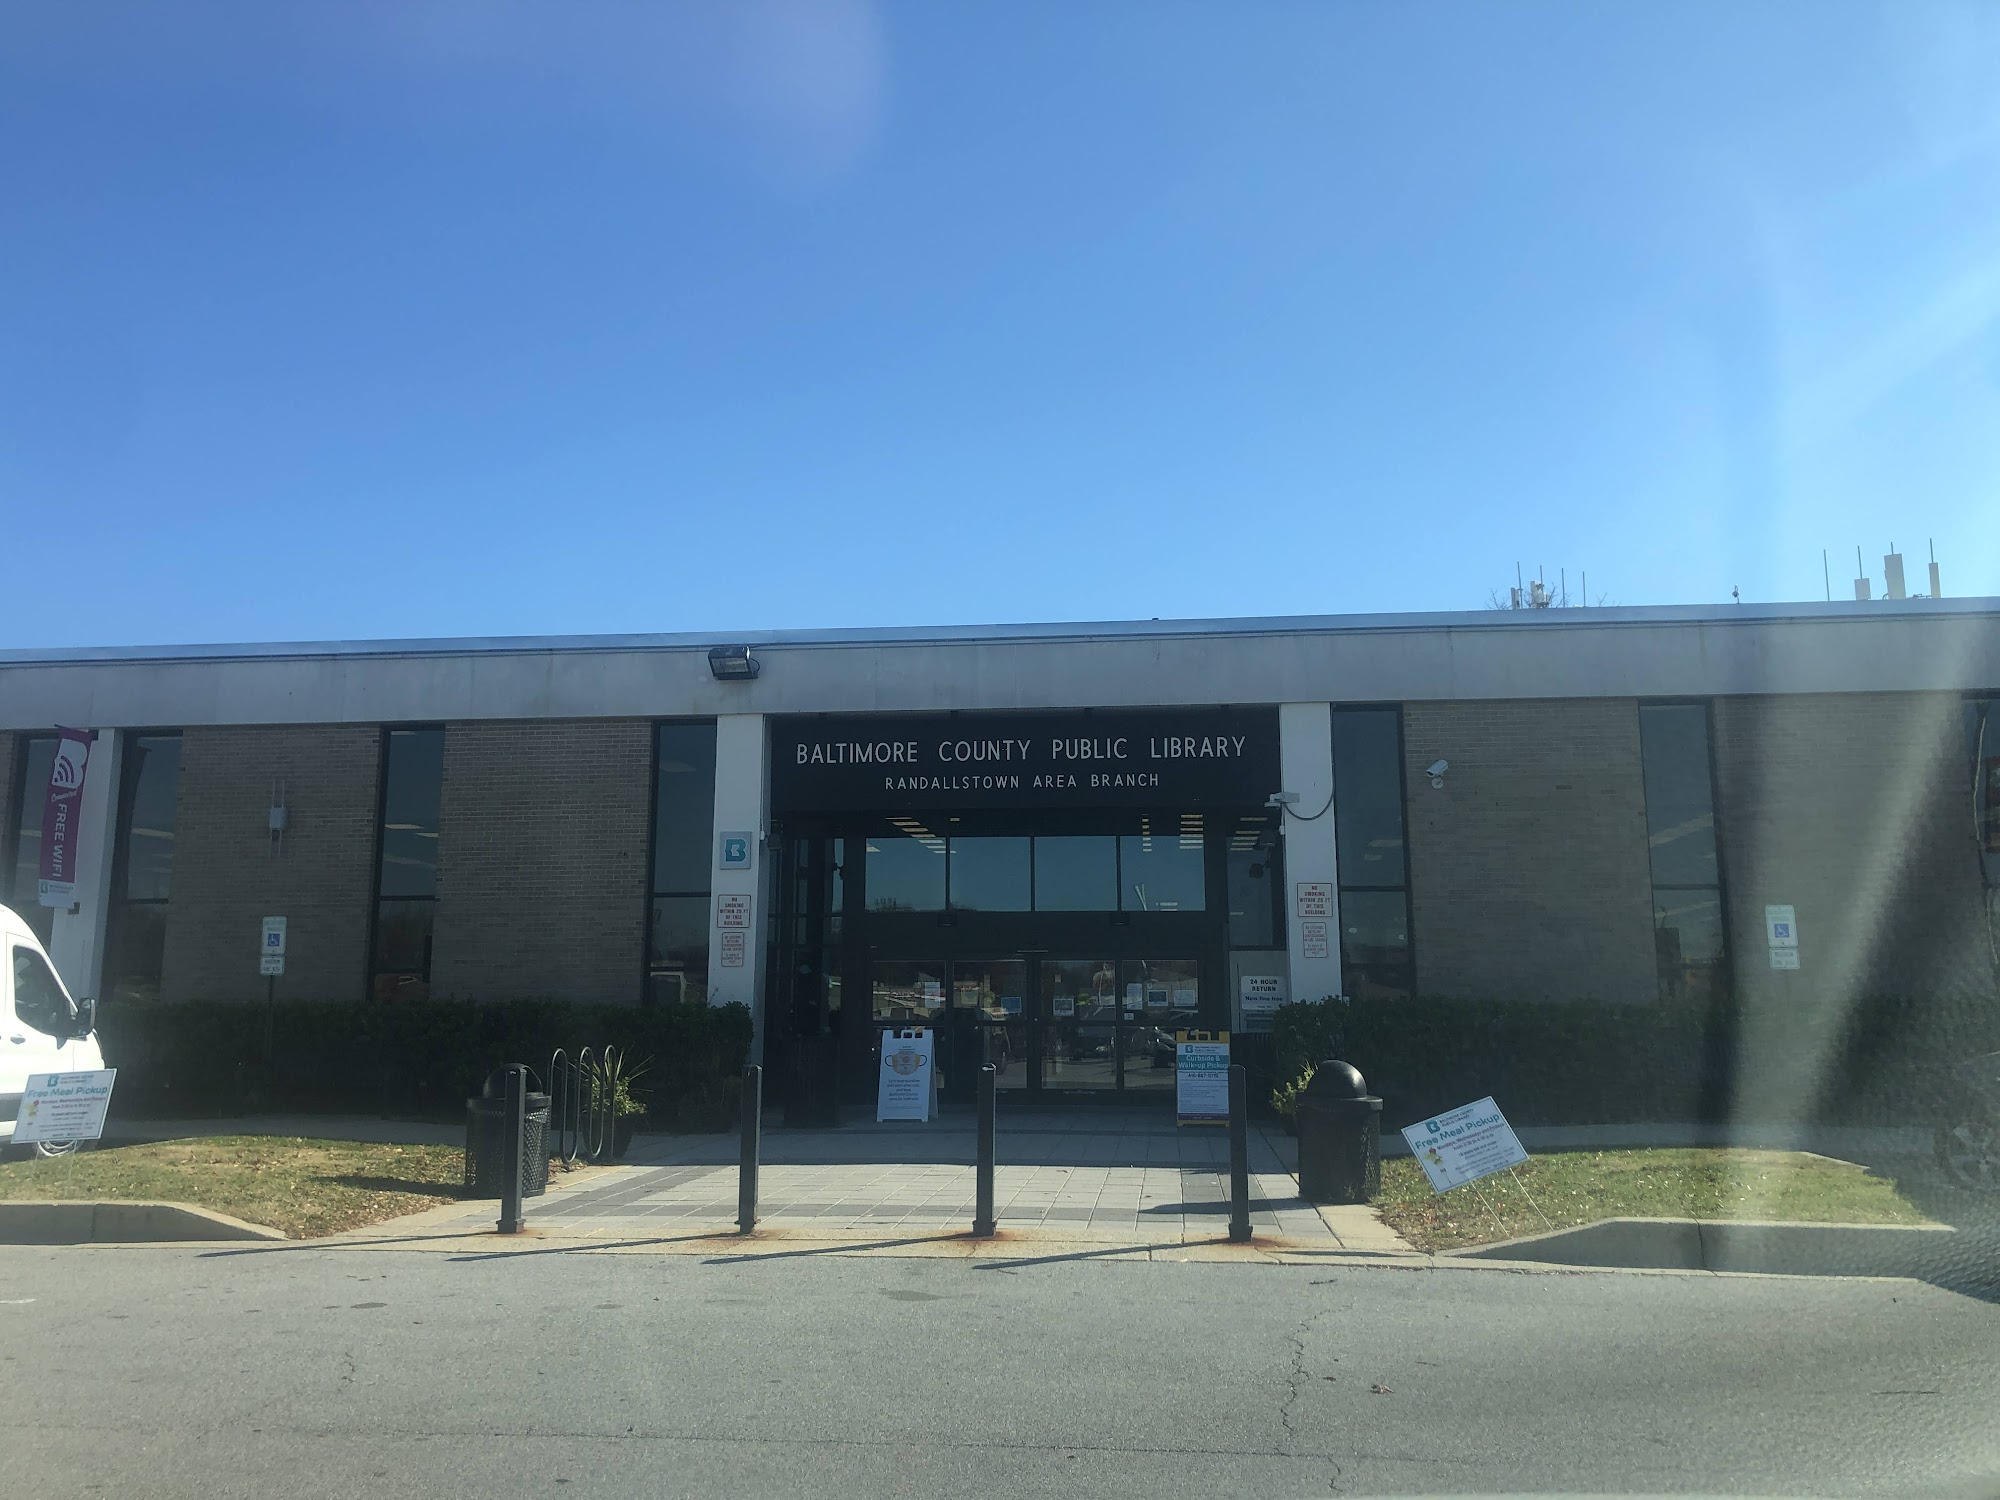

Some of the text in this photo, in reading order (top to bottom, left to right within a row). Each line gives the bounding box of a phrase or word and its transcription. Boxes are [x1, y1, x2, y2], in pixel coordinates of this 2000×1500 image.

[796, 736, 1246, 764] BALTIMORE COUNTY PUBLIC LIBRARY
[885, 773, 1159, 790] RANDALLSTOWN AREA BRANCH
[54, 803, 67, 841] FREE
[52, 844, 63, 877] WIFI
[1178, 1062, 1229, 1070] Walk-up Pickup
[27, 1085, 108, 1098] Free Meal Pickup
[1414, 1113, 1500, 1150] Free Meal Pickup
